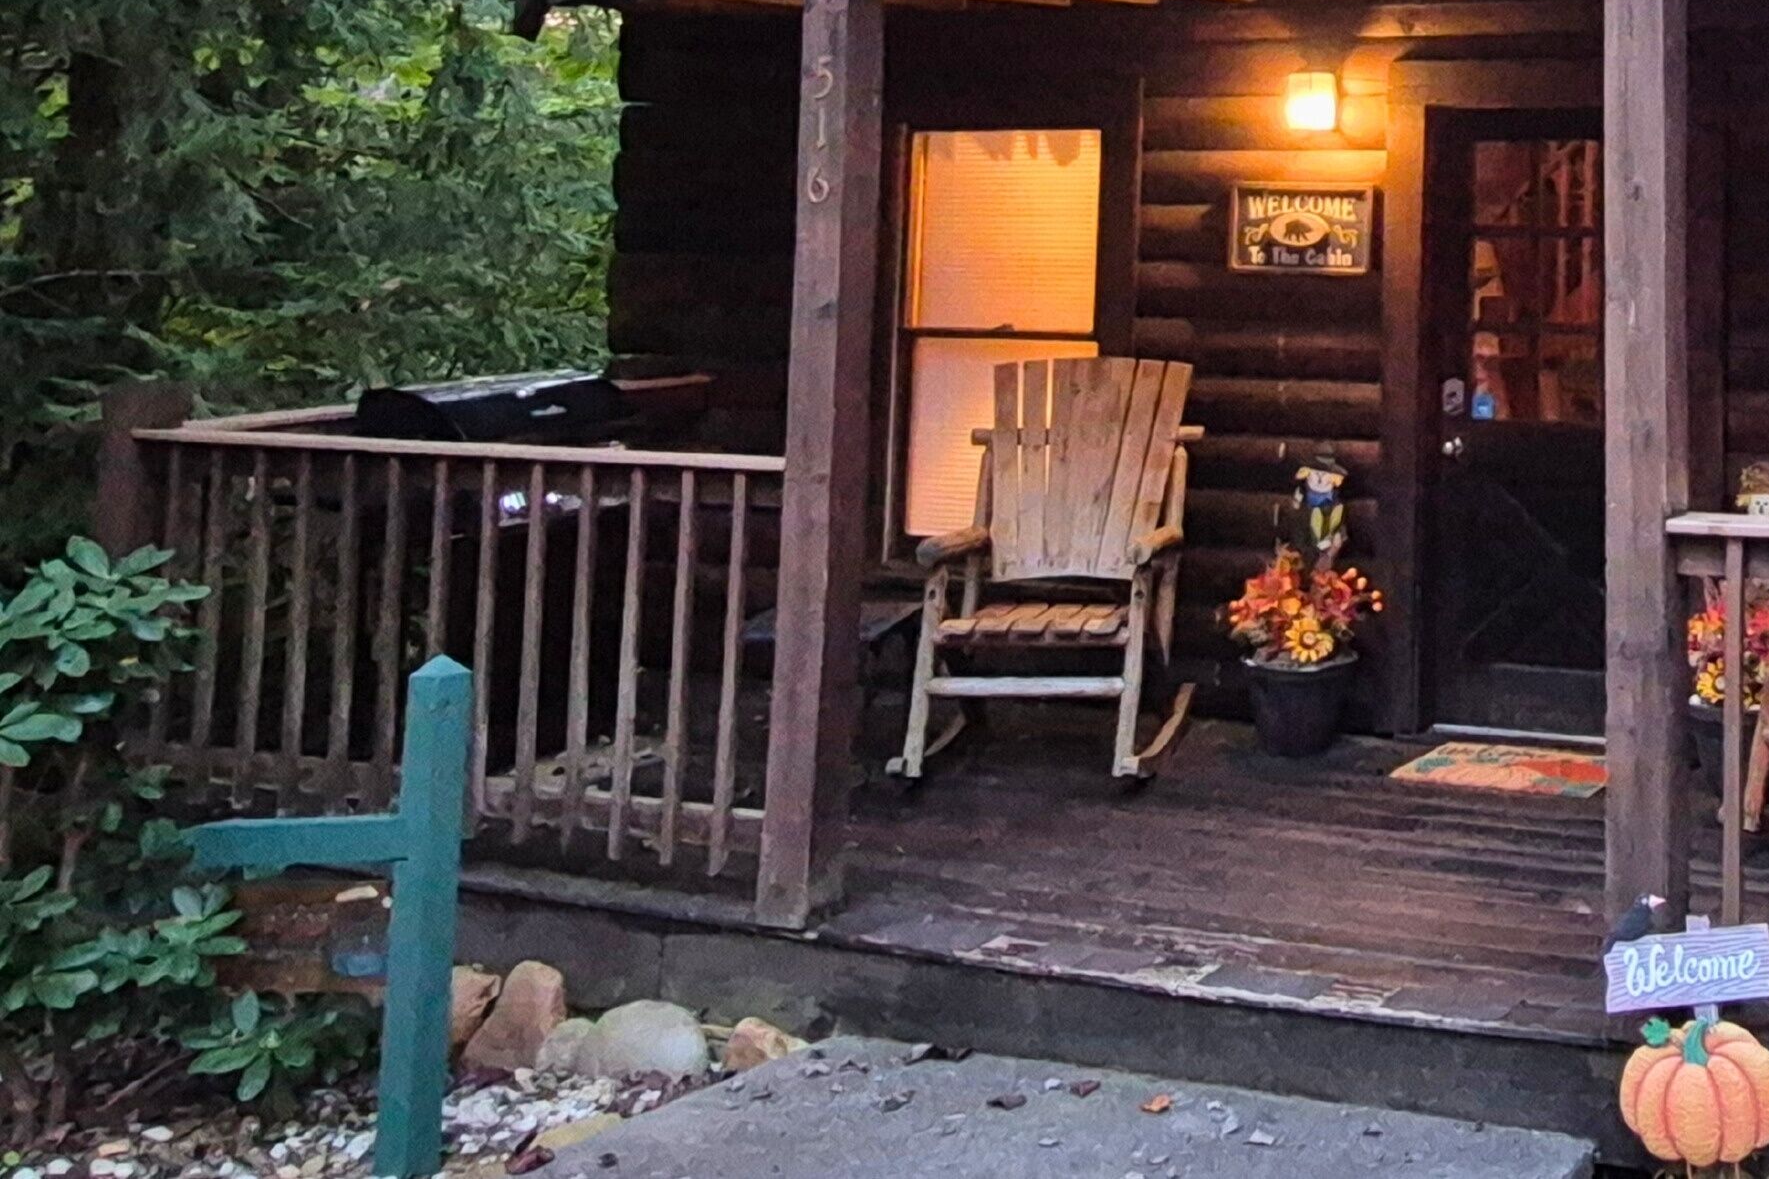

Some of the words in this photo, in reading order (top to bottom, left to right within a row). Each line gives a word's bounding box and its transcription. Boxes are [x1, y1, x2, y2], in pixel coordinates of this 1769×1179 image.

[808, 56, 833, 203] 516
[1248, 195, 1357, 221] WELCOME
[1248, 246, 1265, 265] To
[1272, 245, 1300, 266] The
[1305, 244, 1354, 267] Cabin
[1623, 944, 1761, 996] Welcome
